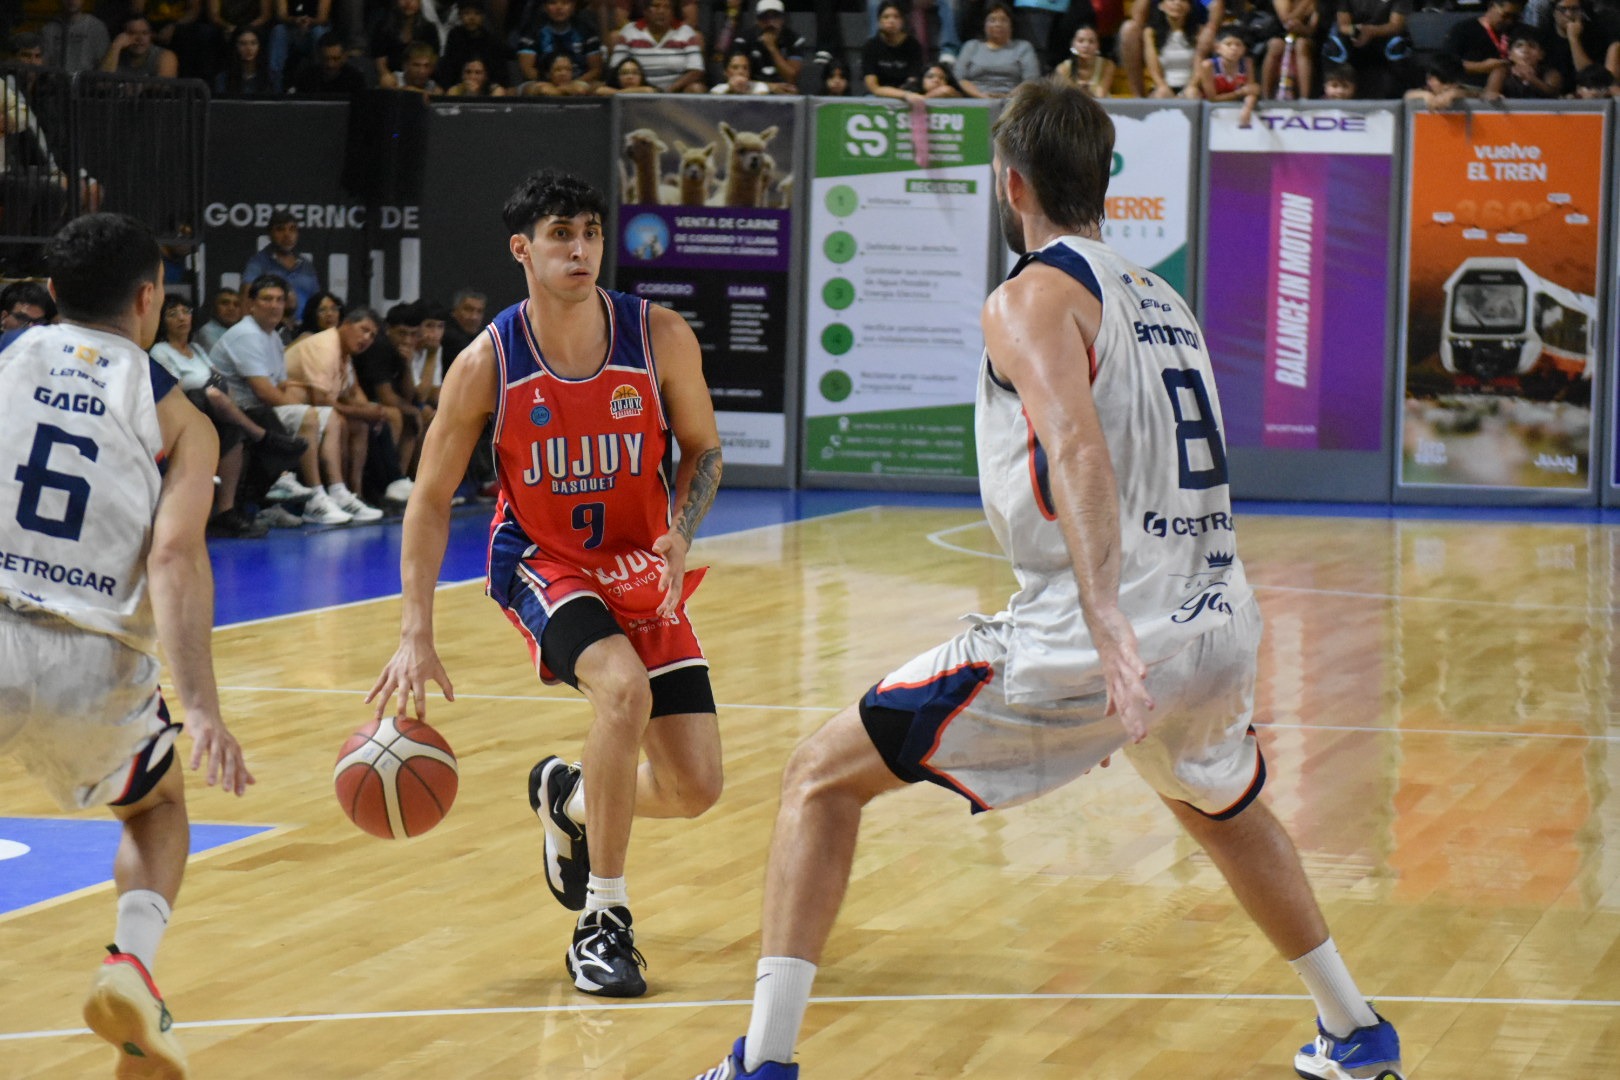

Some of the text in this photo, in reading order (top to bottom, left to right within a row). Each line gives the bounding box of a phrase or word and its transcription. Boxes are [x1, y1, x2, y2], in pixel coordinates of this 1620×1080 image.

[896, 113, 964, 131] SEPU
[1238, 116, 1367, 132] TADE
[1474, 142, 1543, 160] vuelve
[1467, 162, 1548, 182] EL TREN
[204, 202, 419, 229] GOBERNO DE
[675, 216, 779, 231] VENTA DE CARNE
[1275, 192, 1313, 389] BALANCE IN MOTION
[34, 386, 107, 417] GAGO
[611, 397, 641, 412] JUJUY
[1161, 368, 1229, 490] 8
[522, 432, 645, 487] JUJUY
[14, 422, 99, 542] 6
[551, 475, 616, 495] BASQUET
[571, 501, 606, 550] 9
[1172, 511, 1233, 537] CETR
